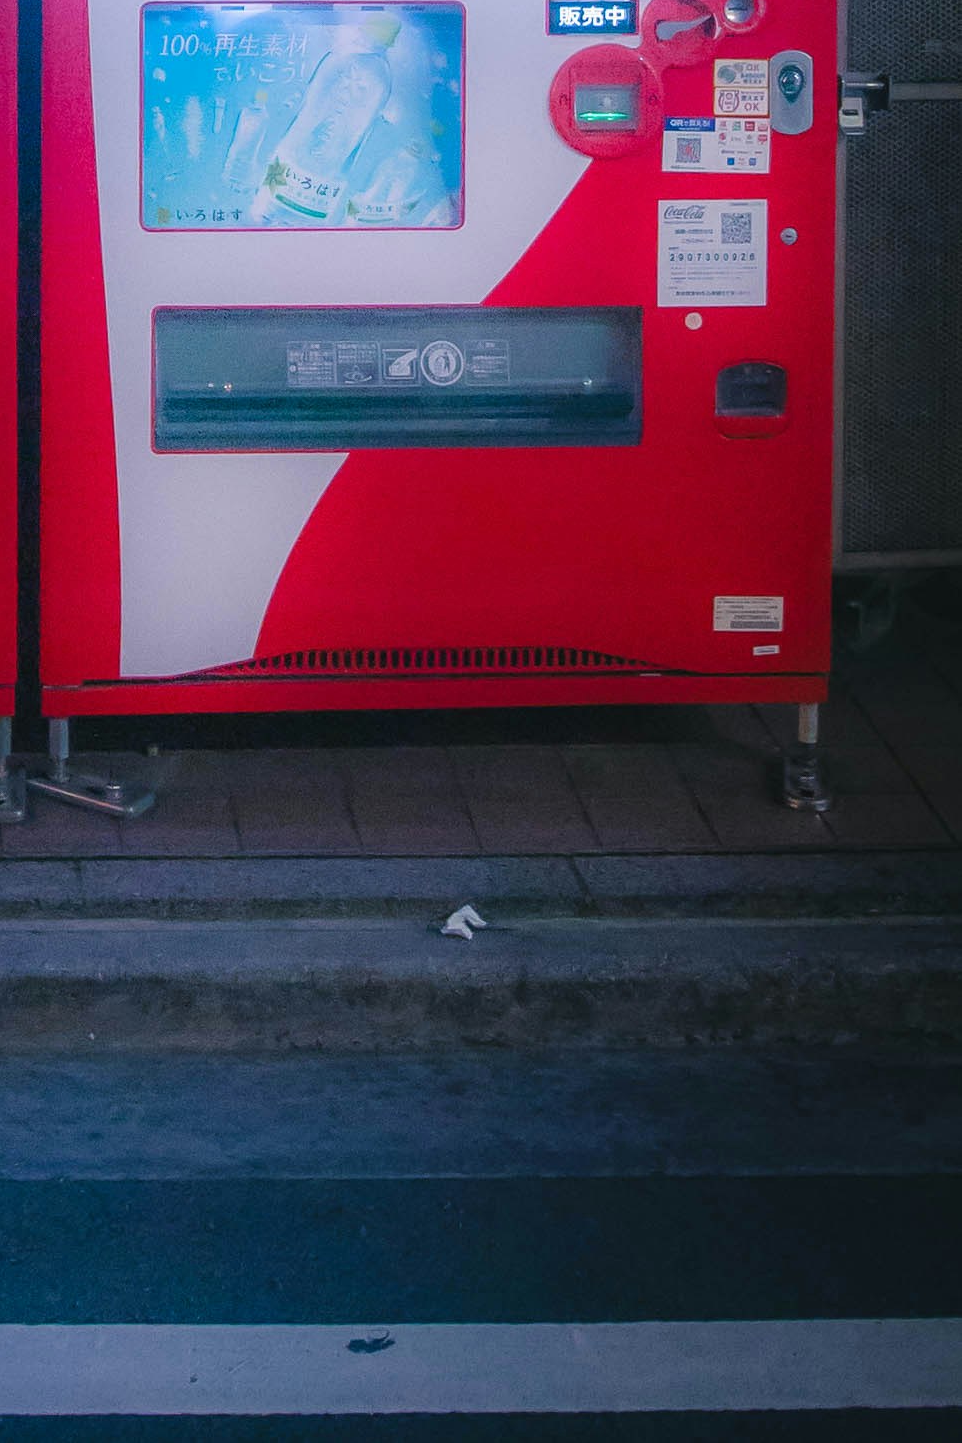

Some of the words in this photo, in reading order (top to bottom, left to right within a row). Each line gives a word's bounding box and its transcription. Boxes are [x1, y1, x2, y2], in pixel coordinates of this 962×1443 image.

[559, 6, 626, 27] 販売中
[744, 103, 759, 111] OK
